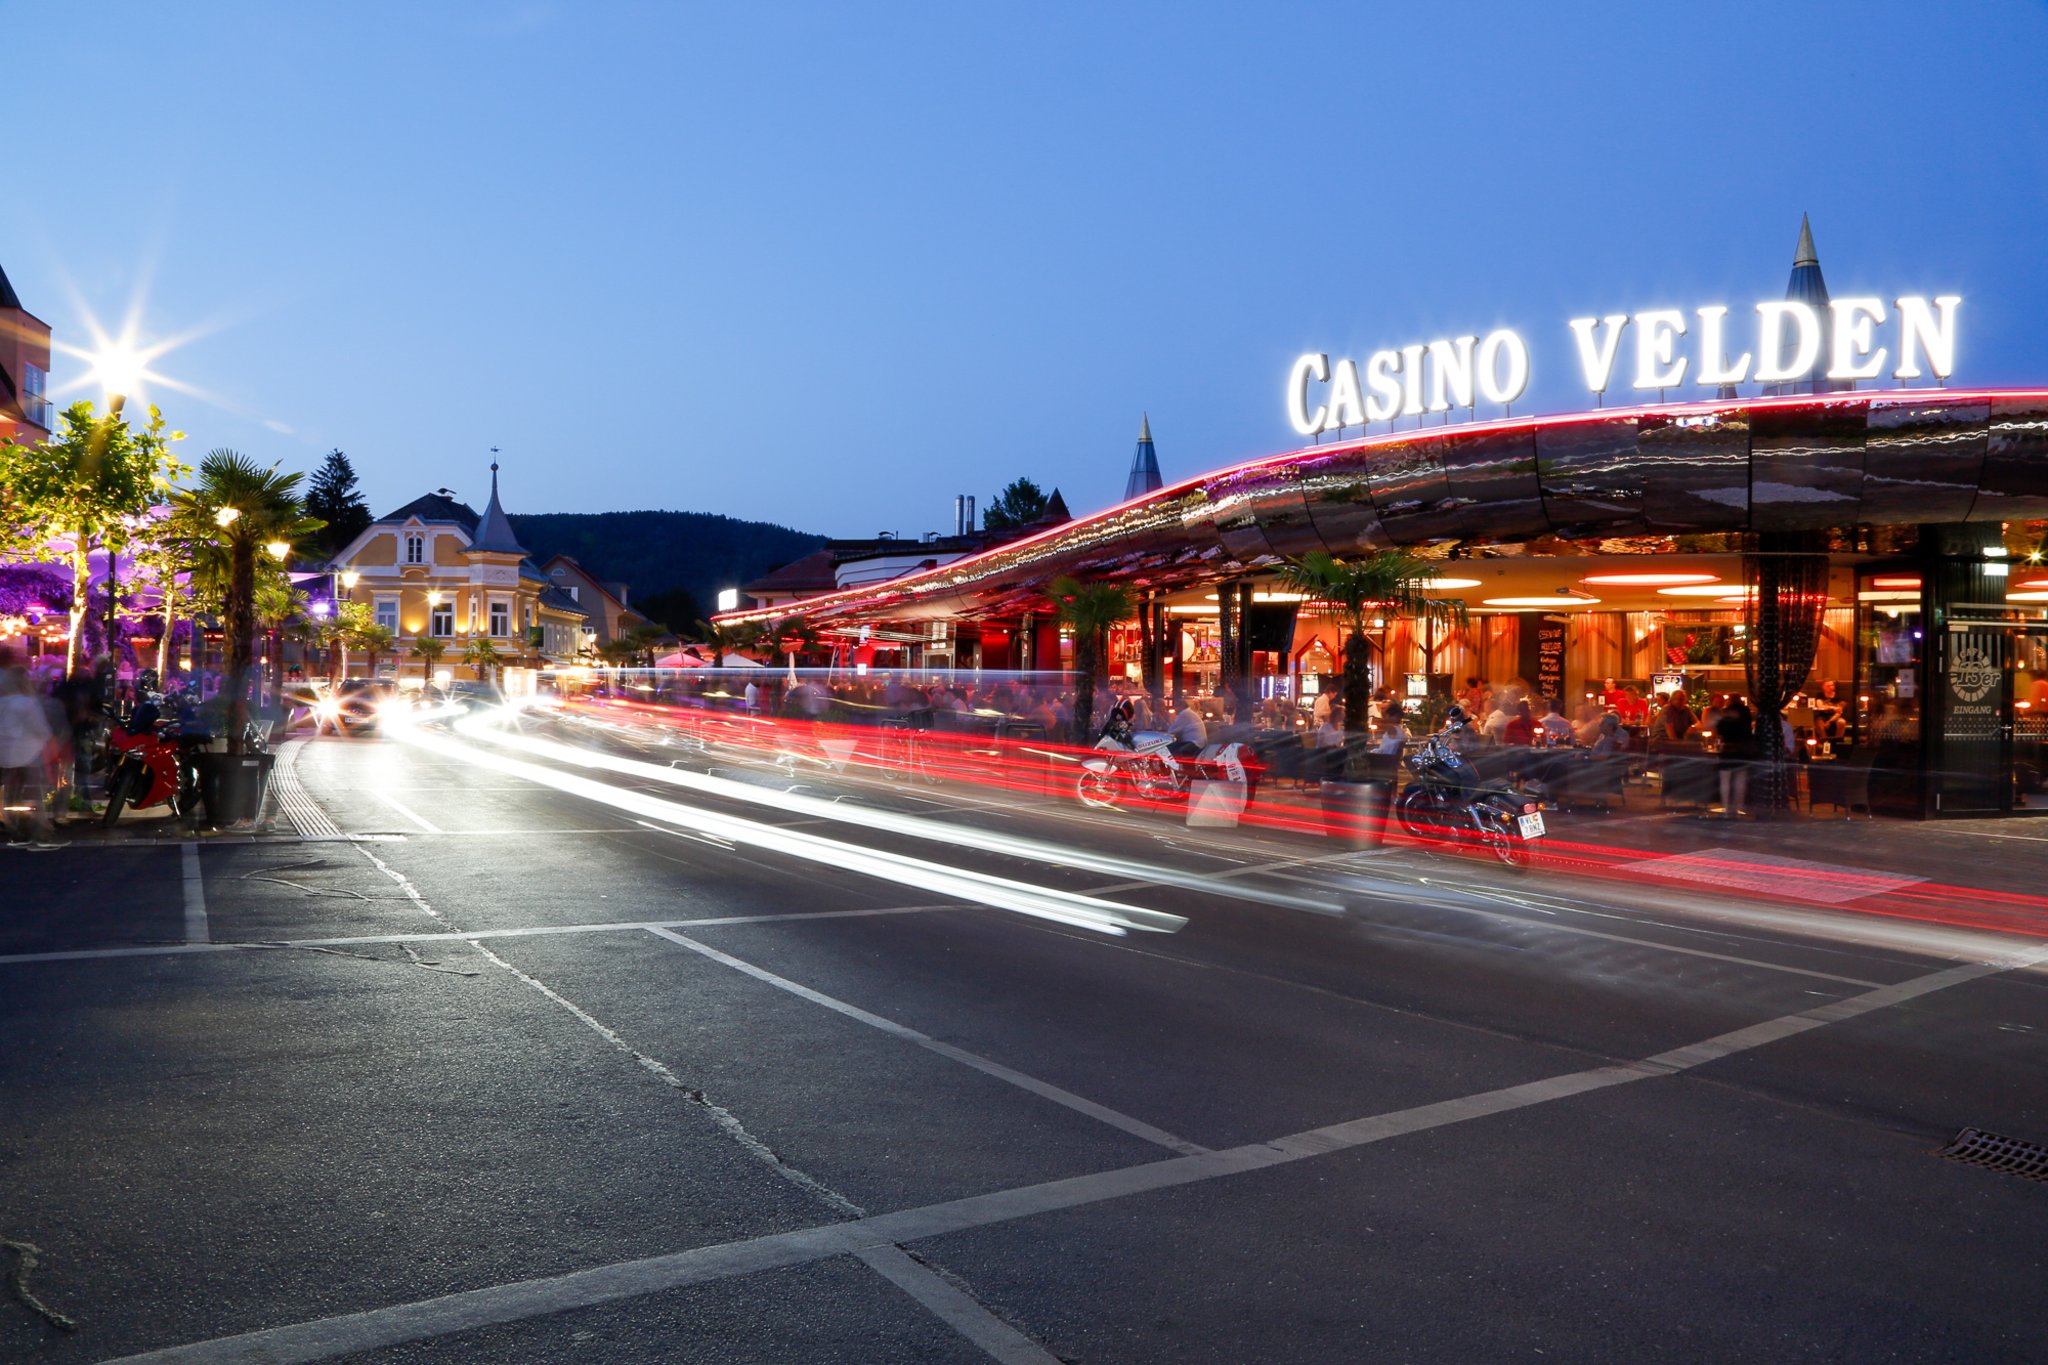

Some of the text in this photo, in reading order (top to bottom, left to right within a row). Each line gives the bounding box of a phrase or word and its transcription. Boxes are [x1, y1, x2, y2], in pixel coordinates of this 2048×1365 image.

[1288, 297, 1961, 435] CASINO VELDEN
[1953, 706, 1991, 714] EINGANG
[1138, 739, 1163, 748] SUZUKI
